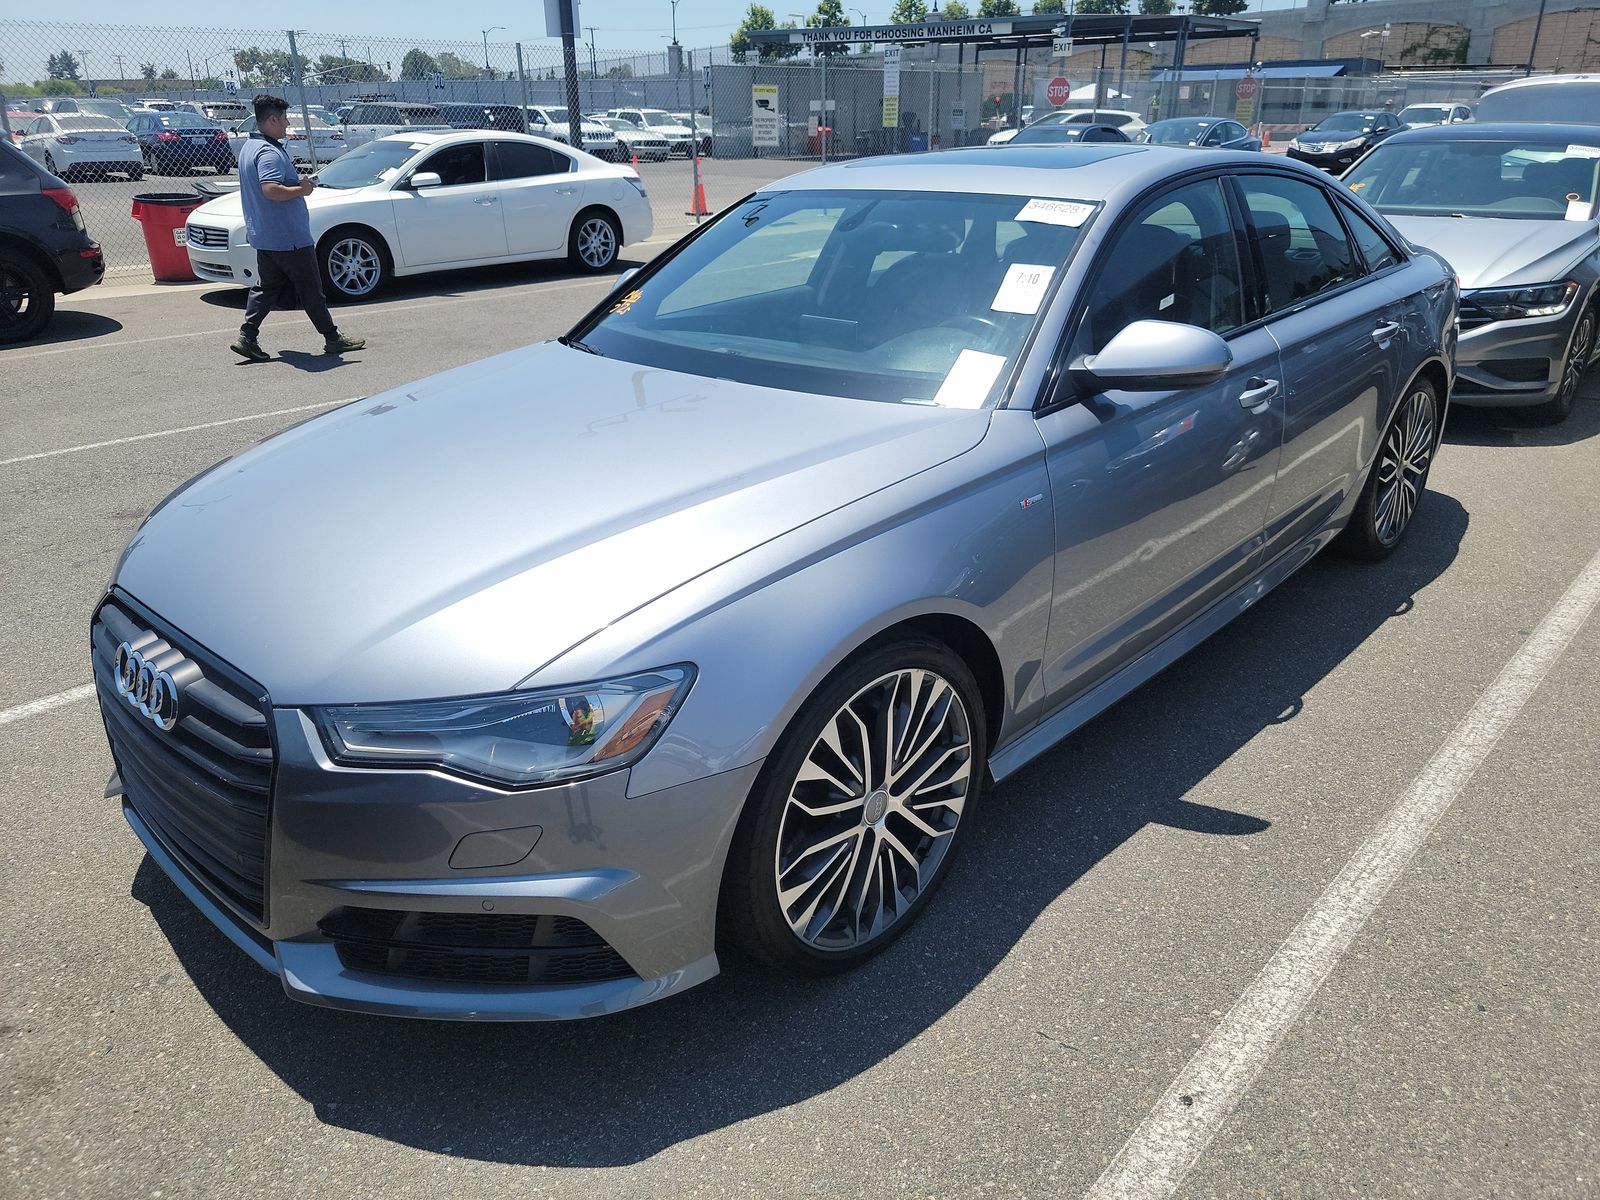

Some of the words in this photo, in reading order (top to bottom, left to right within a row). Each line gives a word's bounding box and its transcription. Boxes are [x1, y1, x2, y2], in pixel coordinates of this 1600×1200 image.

[802, 32, 831, 42] THANK
[833, 31, 851, 41] YOU
[854, 30, 872, 40] FOR
[875, 28, 924, 39] CHOOSING
[927, 24, 975, 37] MANHEIM
[978, 24, 993, 34] CA
[1053, 43, 1072, 52] EXIT
[884, 49, 900, 58] EXIT
[1048, 86, 1069, 97] STOP
[1237, 83, 1256, 93] STOP
[1029, 201, 1087, 214] 3466281
[1016, 271, 1041, 285] 7:10
